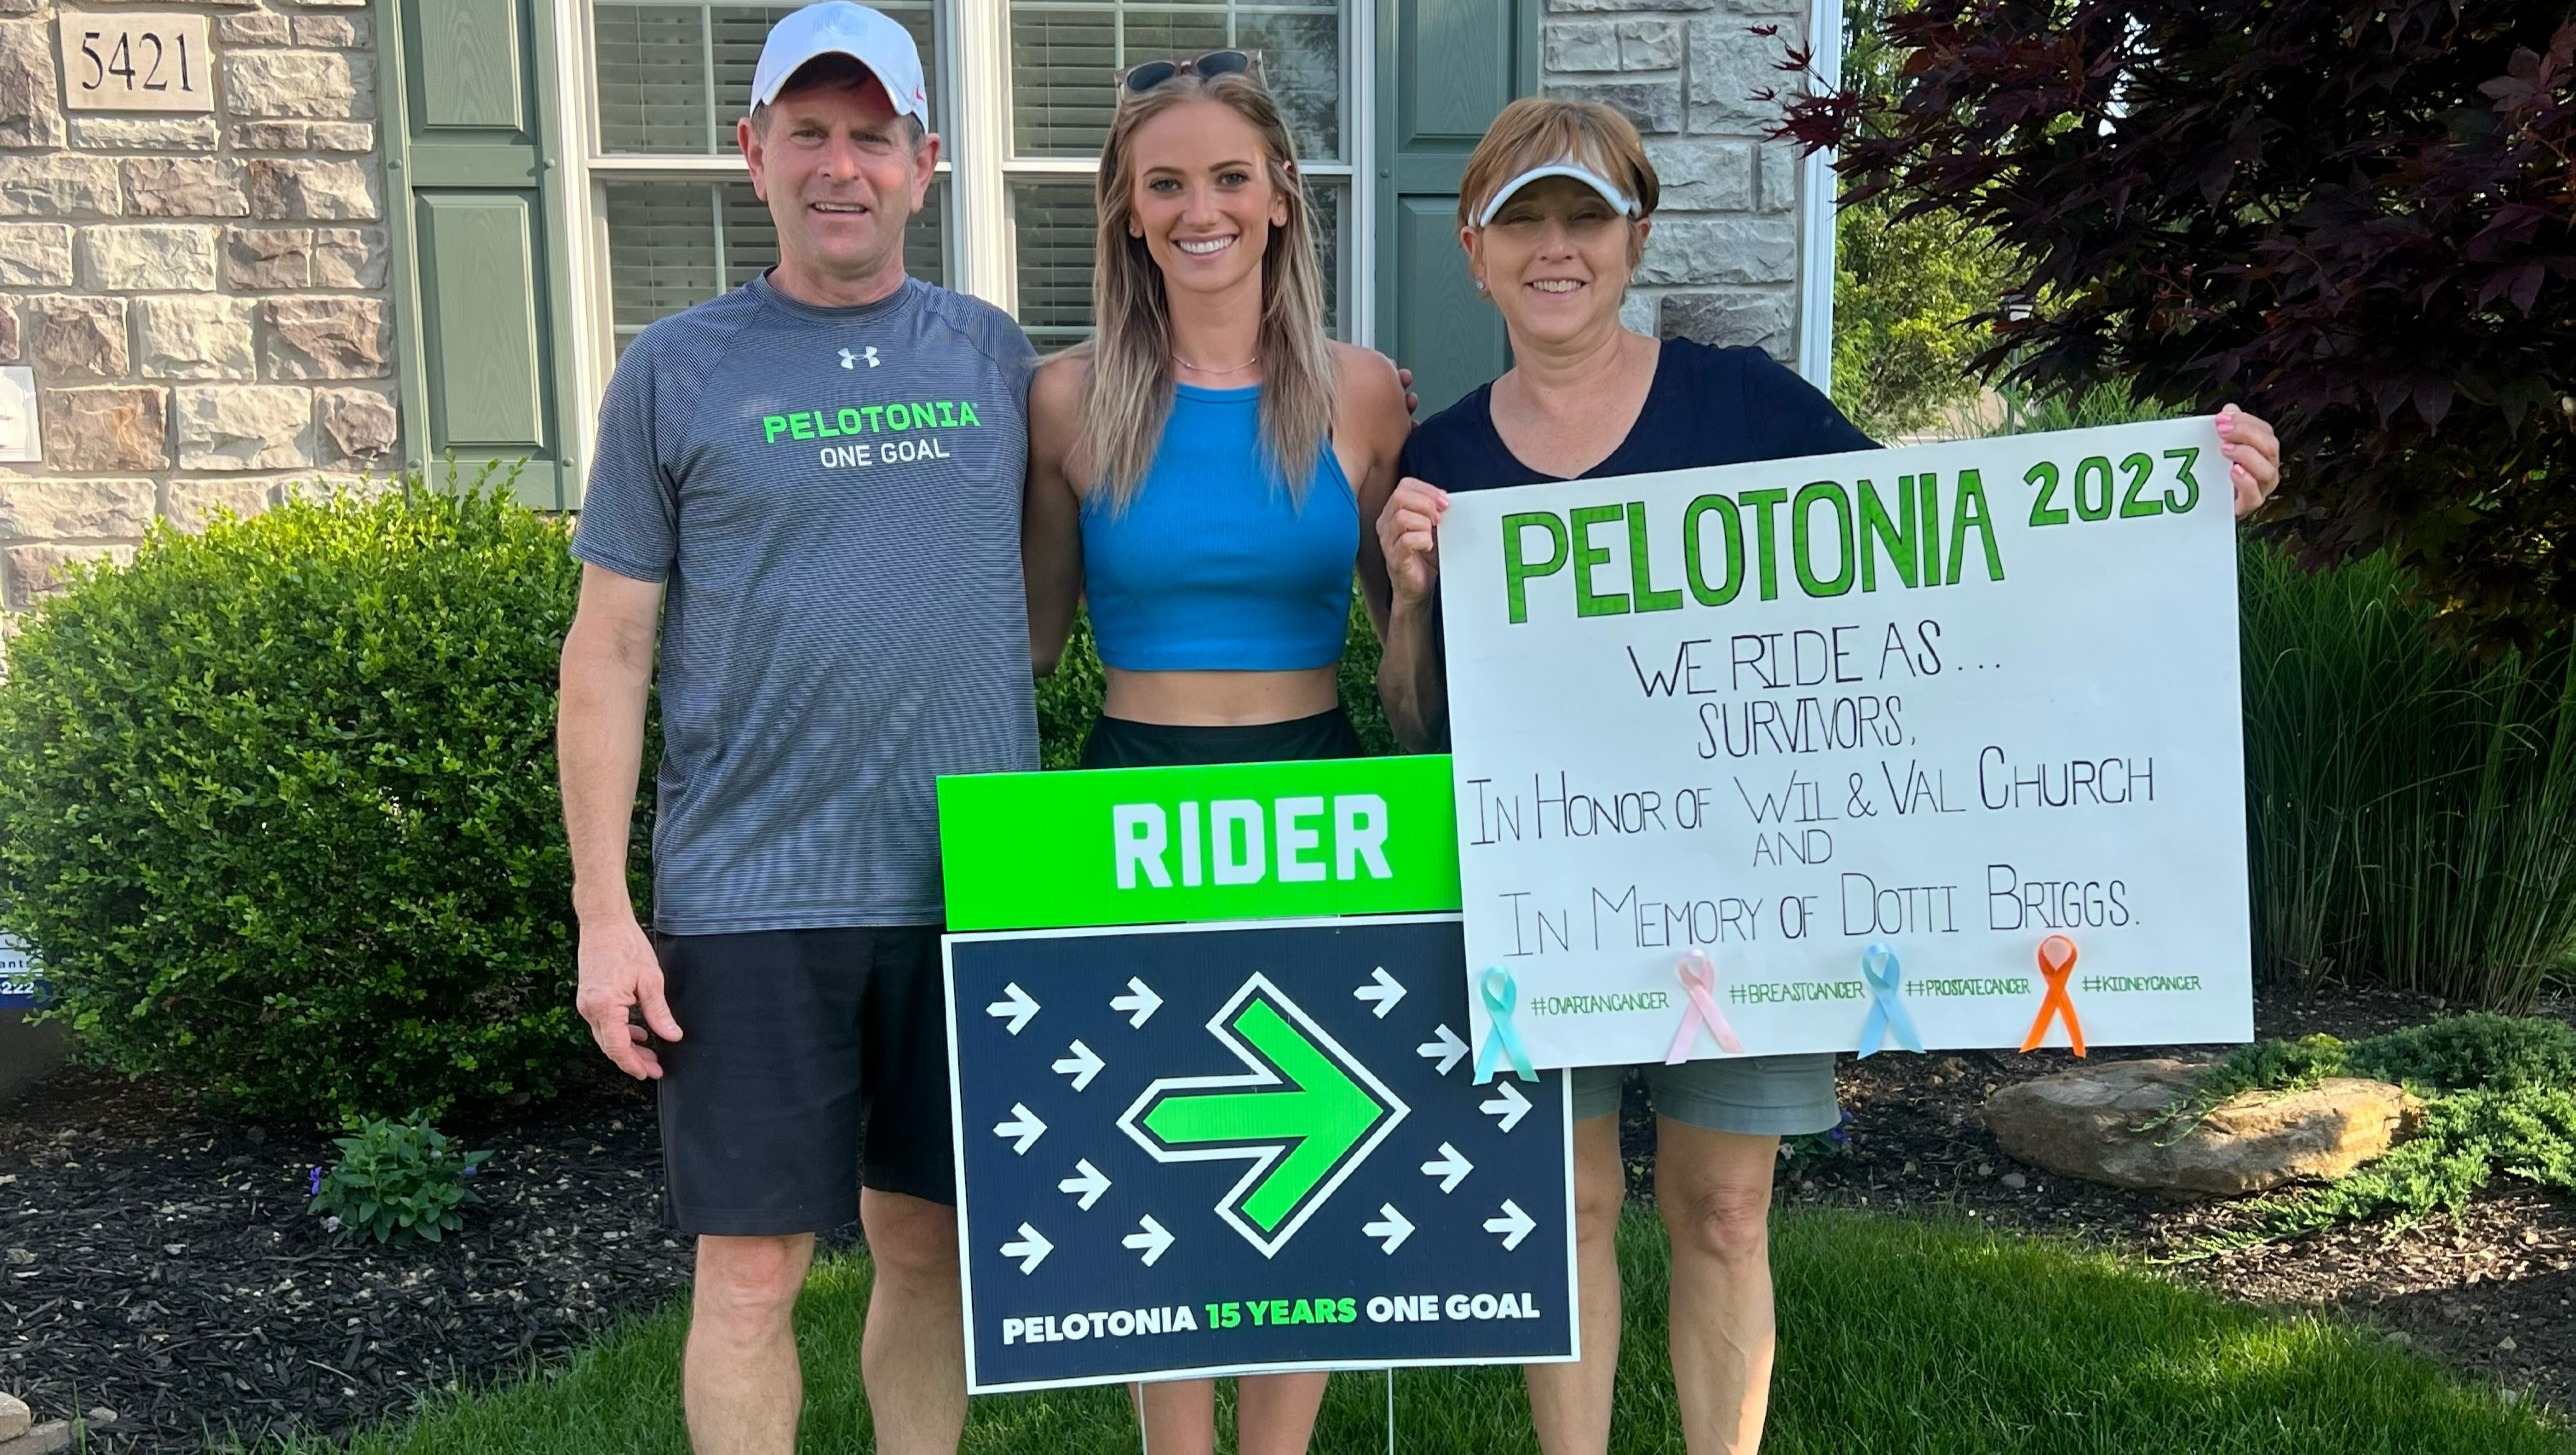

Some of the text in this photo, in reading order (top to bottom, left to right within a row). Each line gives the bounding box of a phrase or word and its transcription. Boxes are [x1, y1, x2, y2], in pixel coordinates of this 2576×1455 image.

[82, 31, 193, 92] 5421
[763, 401, 981, 443] PELOTONIA
[820, 438, 950, 468] ONE GOAL
[1502, 447, 2200, 624] PELOTONIA 2023
[1627, 640, 1717, 697] WE
[1732, 626, 1862, 690] RIDE
[1699, 695, 1915, 759] SURVIVORS,
[1675, 788, 1712, 829] OF
[1847, 773, 1878, 818] &
[1979, 746, 2154, 810] CHURCH
[1113, 794, 1393, 889] RIDER
[1754, 829, 1832, 867] AND
[1592, 884, 1763, 950] MEMORY
[1780, 896, 1818, 939] OF
[1531, 975, 2202, 1015] #OVARIANCANCER #BREASTCANCER #PROSTATECANCER #KIDNEYCANCER
[1003, 1293, 1540, 1346] PELOTONIA 15 YEARS ONE GOAL
